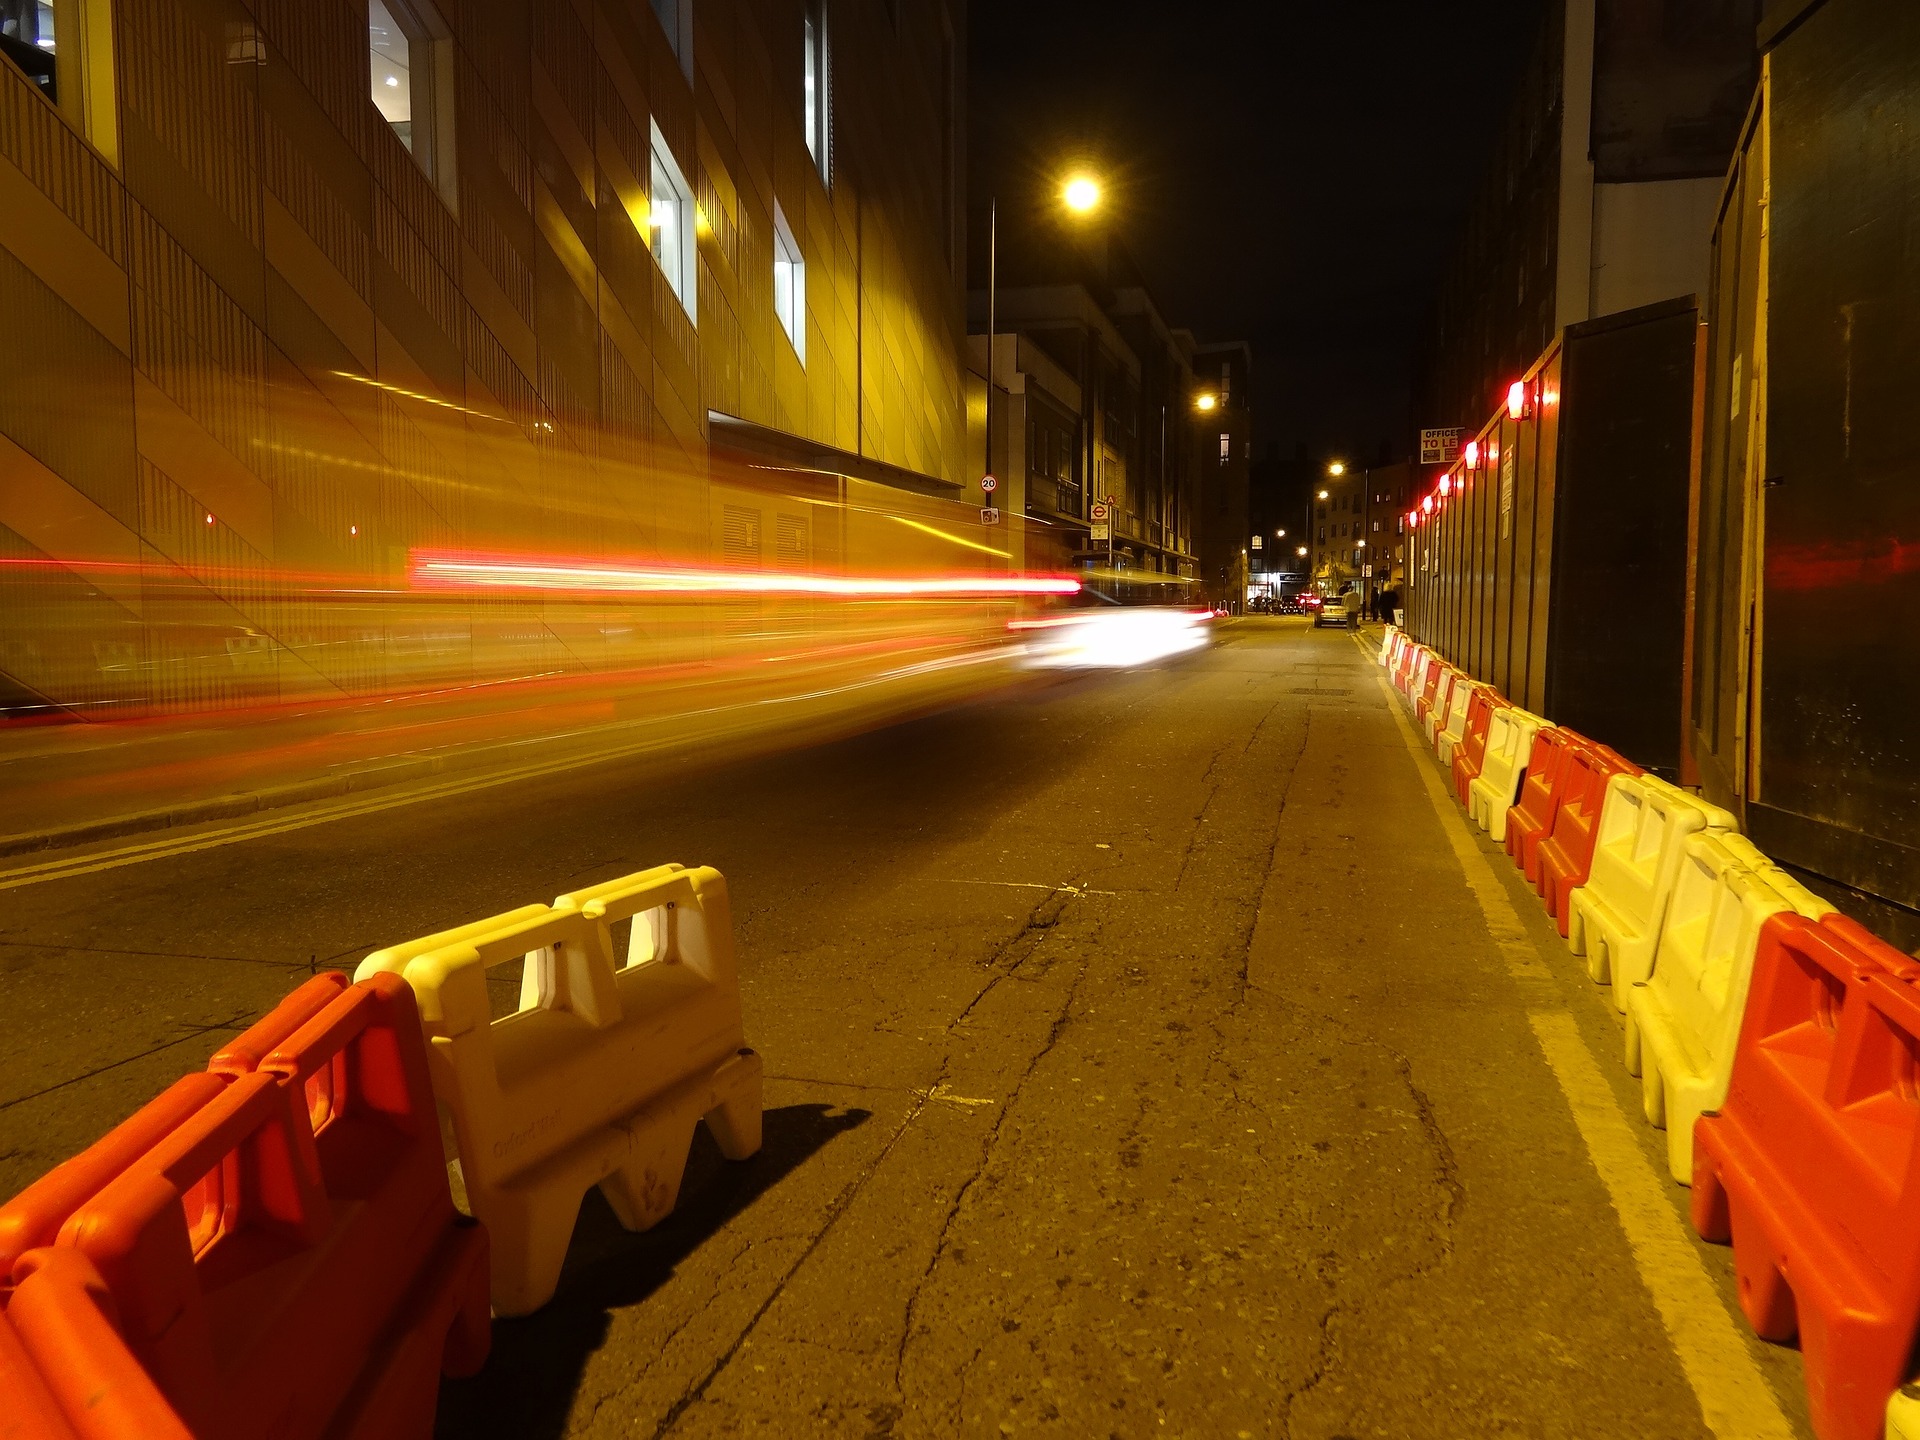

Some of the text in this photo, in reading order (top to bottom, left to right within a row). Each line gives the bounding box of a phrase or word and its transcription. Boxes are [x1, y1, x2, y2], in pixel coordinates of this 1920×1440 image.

[1423, 438, 1458, 448] TO LE
[983, 479, 995, 488] 20
